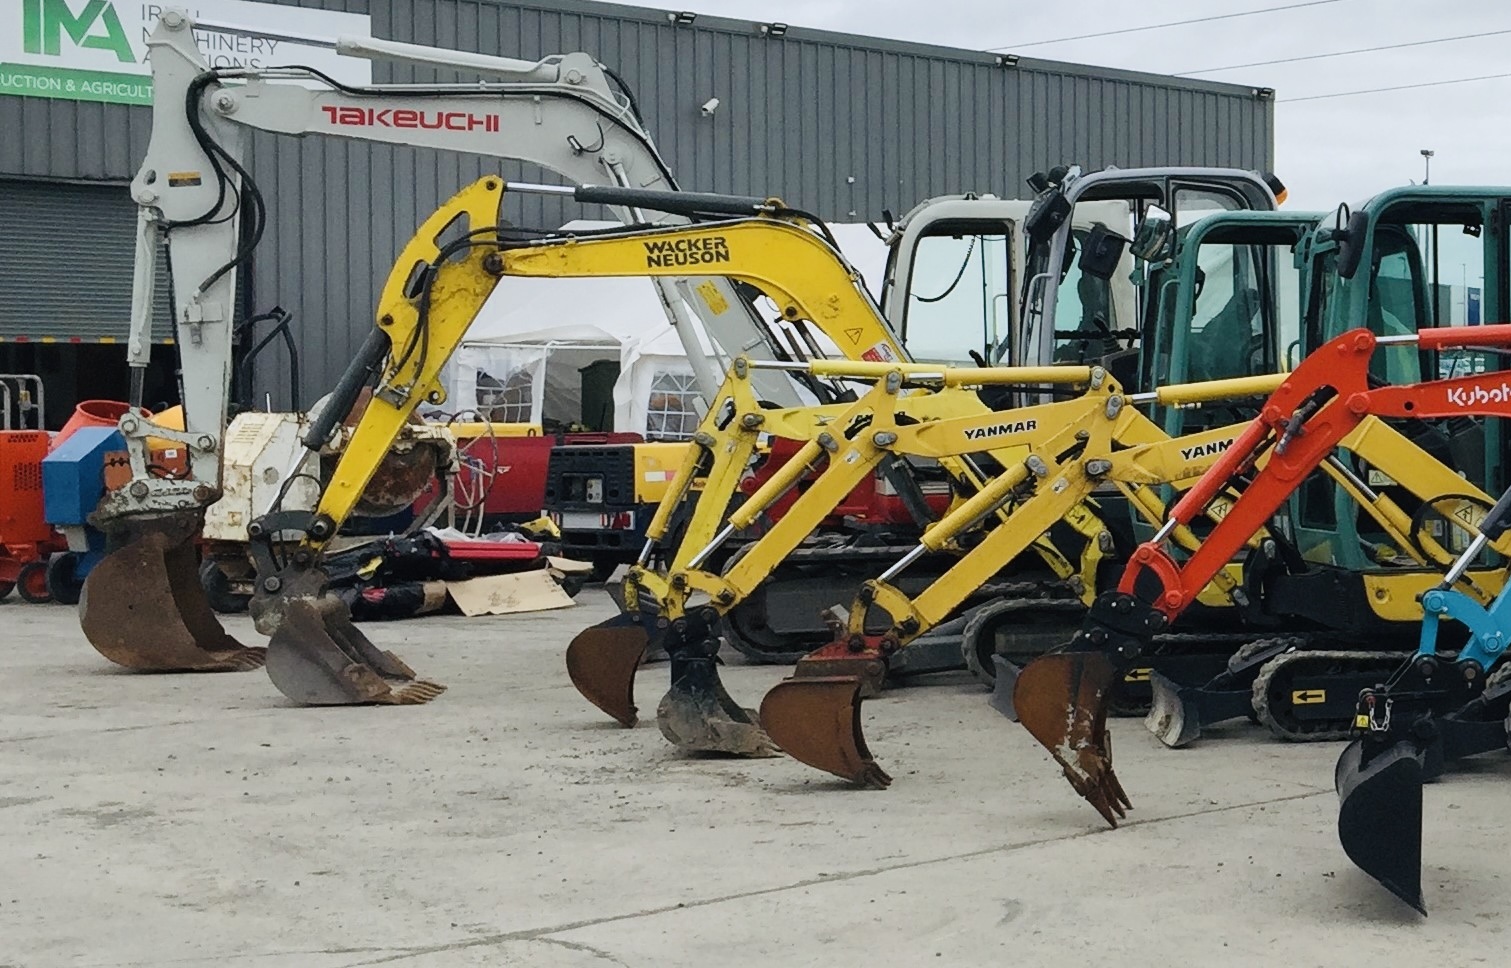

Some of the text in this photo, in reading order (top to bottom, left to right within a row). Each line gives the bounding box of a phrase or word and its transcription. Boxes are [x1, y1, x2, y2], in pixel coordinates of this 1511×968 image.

[0, 74, 61, 91] UCTION
[65, 79, 76, 92] &
[643, 237, 728, 254] WACKER
[647, 250, 730, 268] NEUSON
[964, 420, 1037, 440] YANMAR
